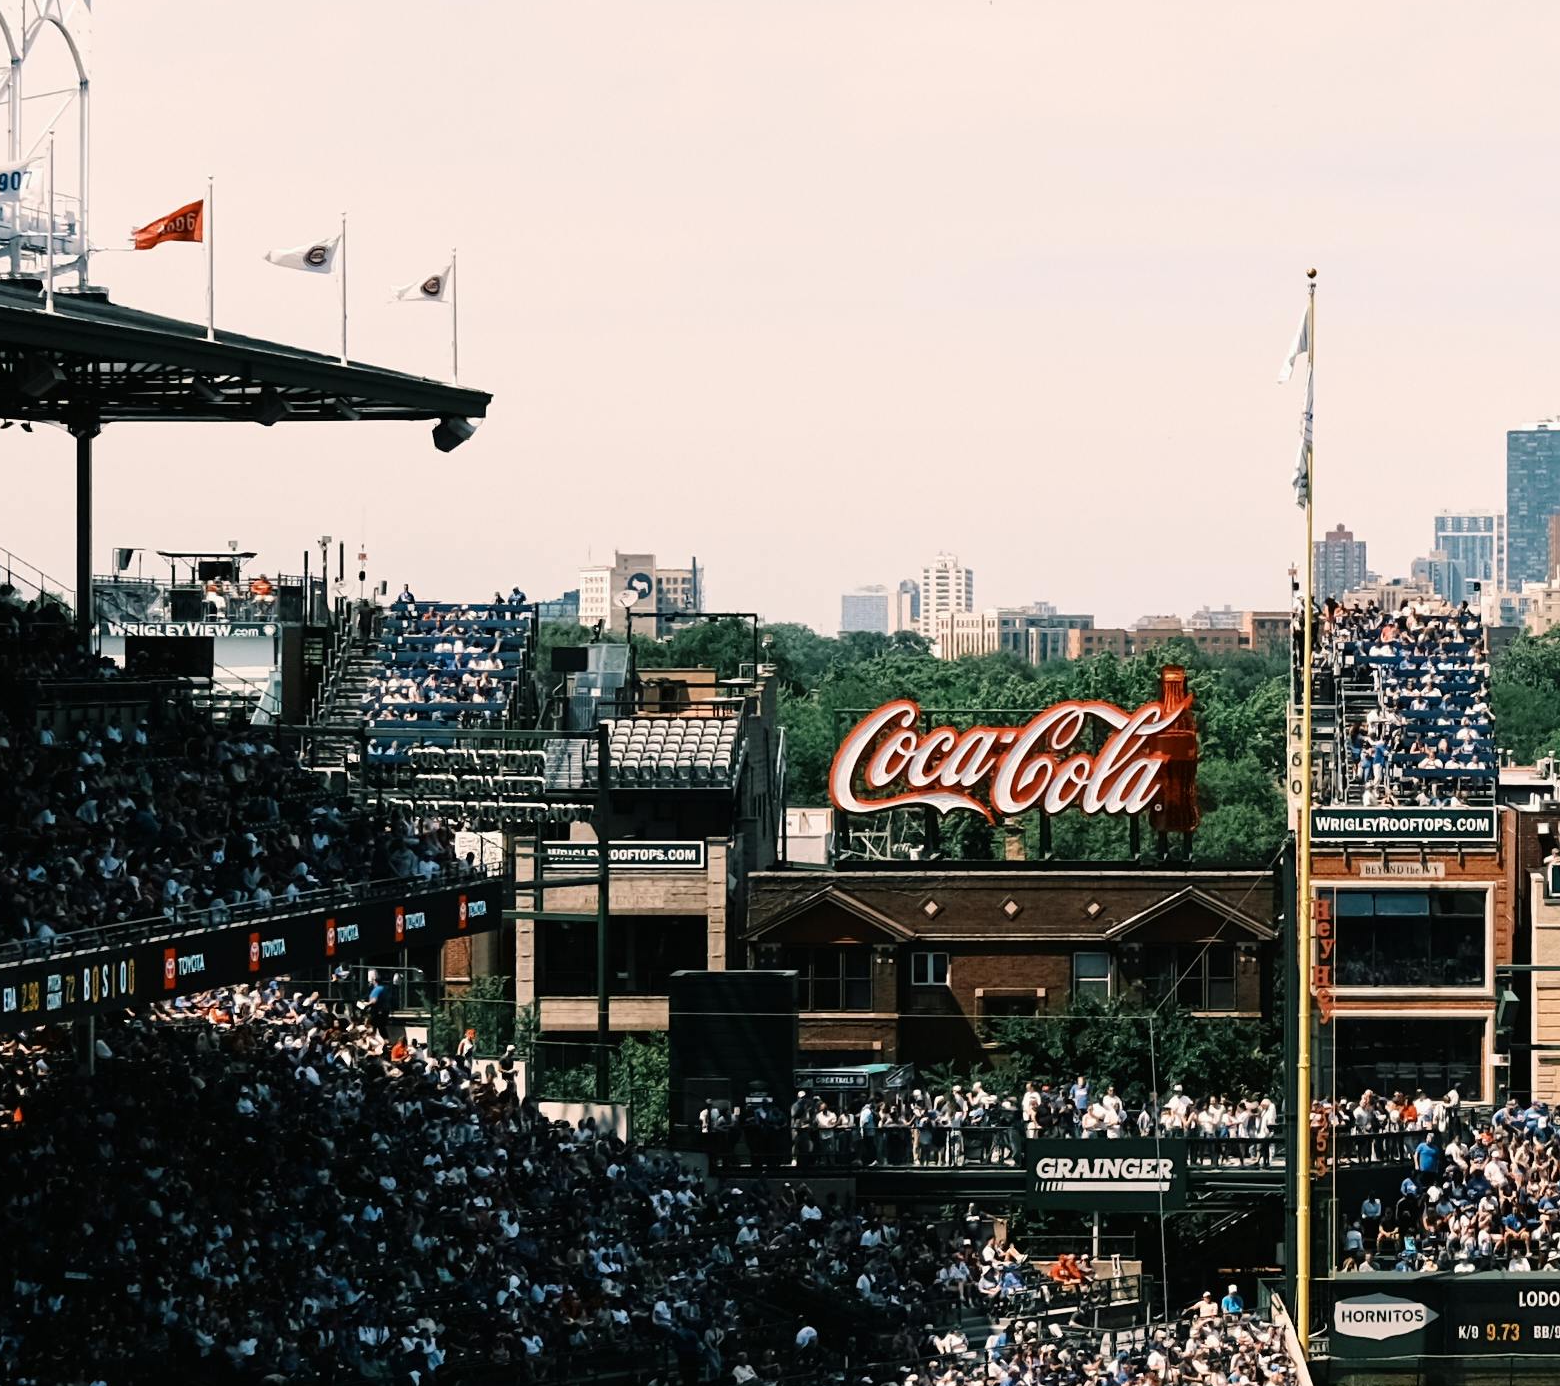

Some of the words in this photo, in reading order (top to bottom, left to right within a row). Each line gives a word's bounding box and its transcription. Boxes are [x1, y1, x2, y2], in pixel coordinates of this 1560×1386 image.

[830, 700, 1193, 823] Coca-Cola
[1365, 865, 1404, 875] BEYOND
[468, 901, 487, 918] TOYOTA
[405, 912, 426, 931] TOYOTA
[337, 924, 360, 944] TOYOTA
[261, 938, 286, 959] TOYOTA
[178, 953, 205, 976] TOYOTA
[83, 967, 90, 1002] B
[102, 963, 109, 998] S
[3, 986, 17, 1013] ERA
[1036, 1157, 1173, 1180] GRAINGER
[1341, 1308, 1424, 1324] HORNITOS
[1486, 1324, 1520, 1342] 9.73
